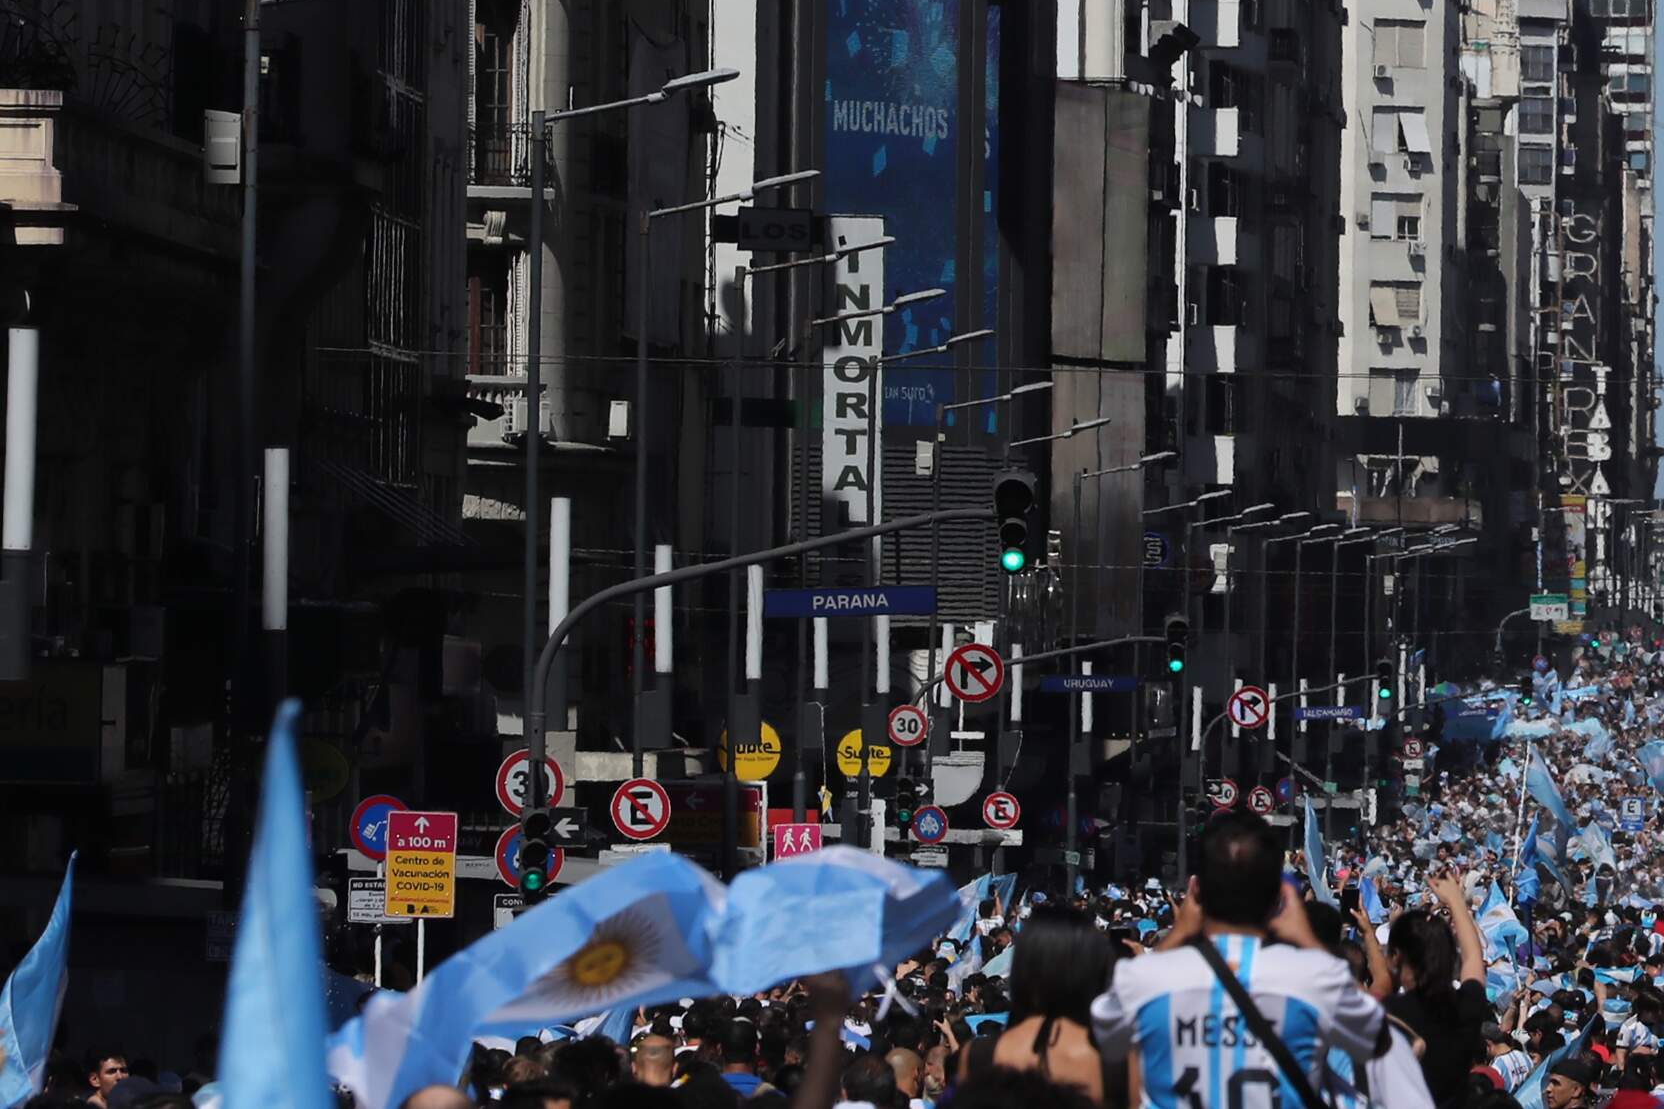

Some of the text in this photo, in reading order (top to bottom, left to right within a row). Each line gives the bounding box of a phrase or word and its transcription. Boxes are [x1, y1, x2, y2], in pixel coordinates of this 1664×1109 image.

[832, 99, 950, 140] MUCHACHOS
[811, 594, 889, 612] PARANA
[896, 717, 919, 735] 30
[408, 836, 432, 848] 100
[394, 855, 445, 866] Centro de
[396, 881, 445, 891] COVID-19
